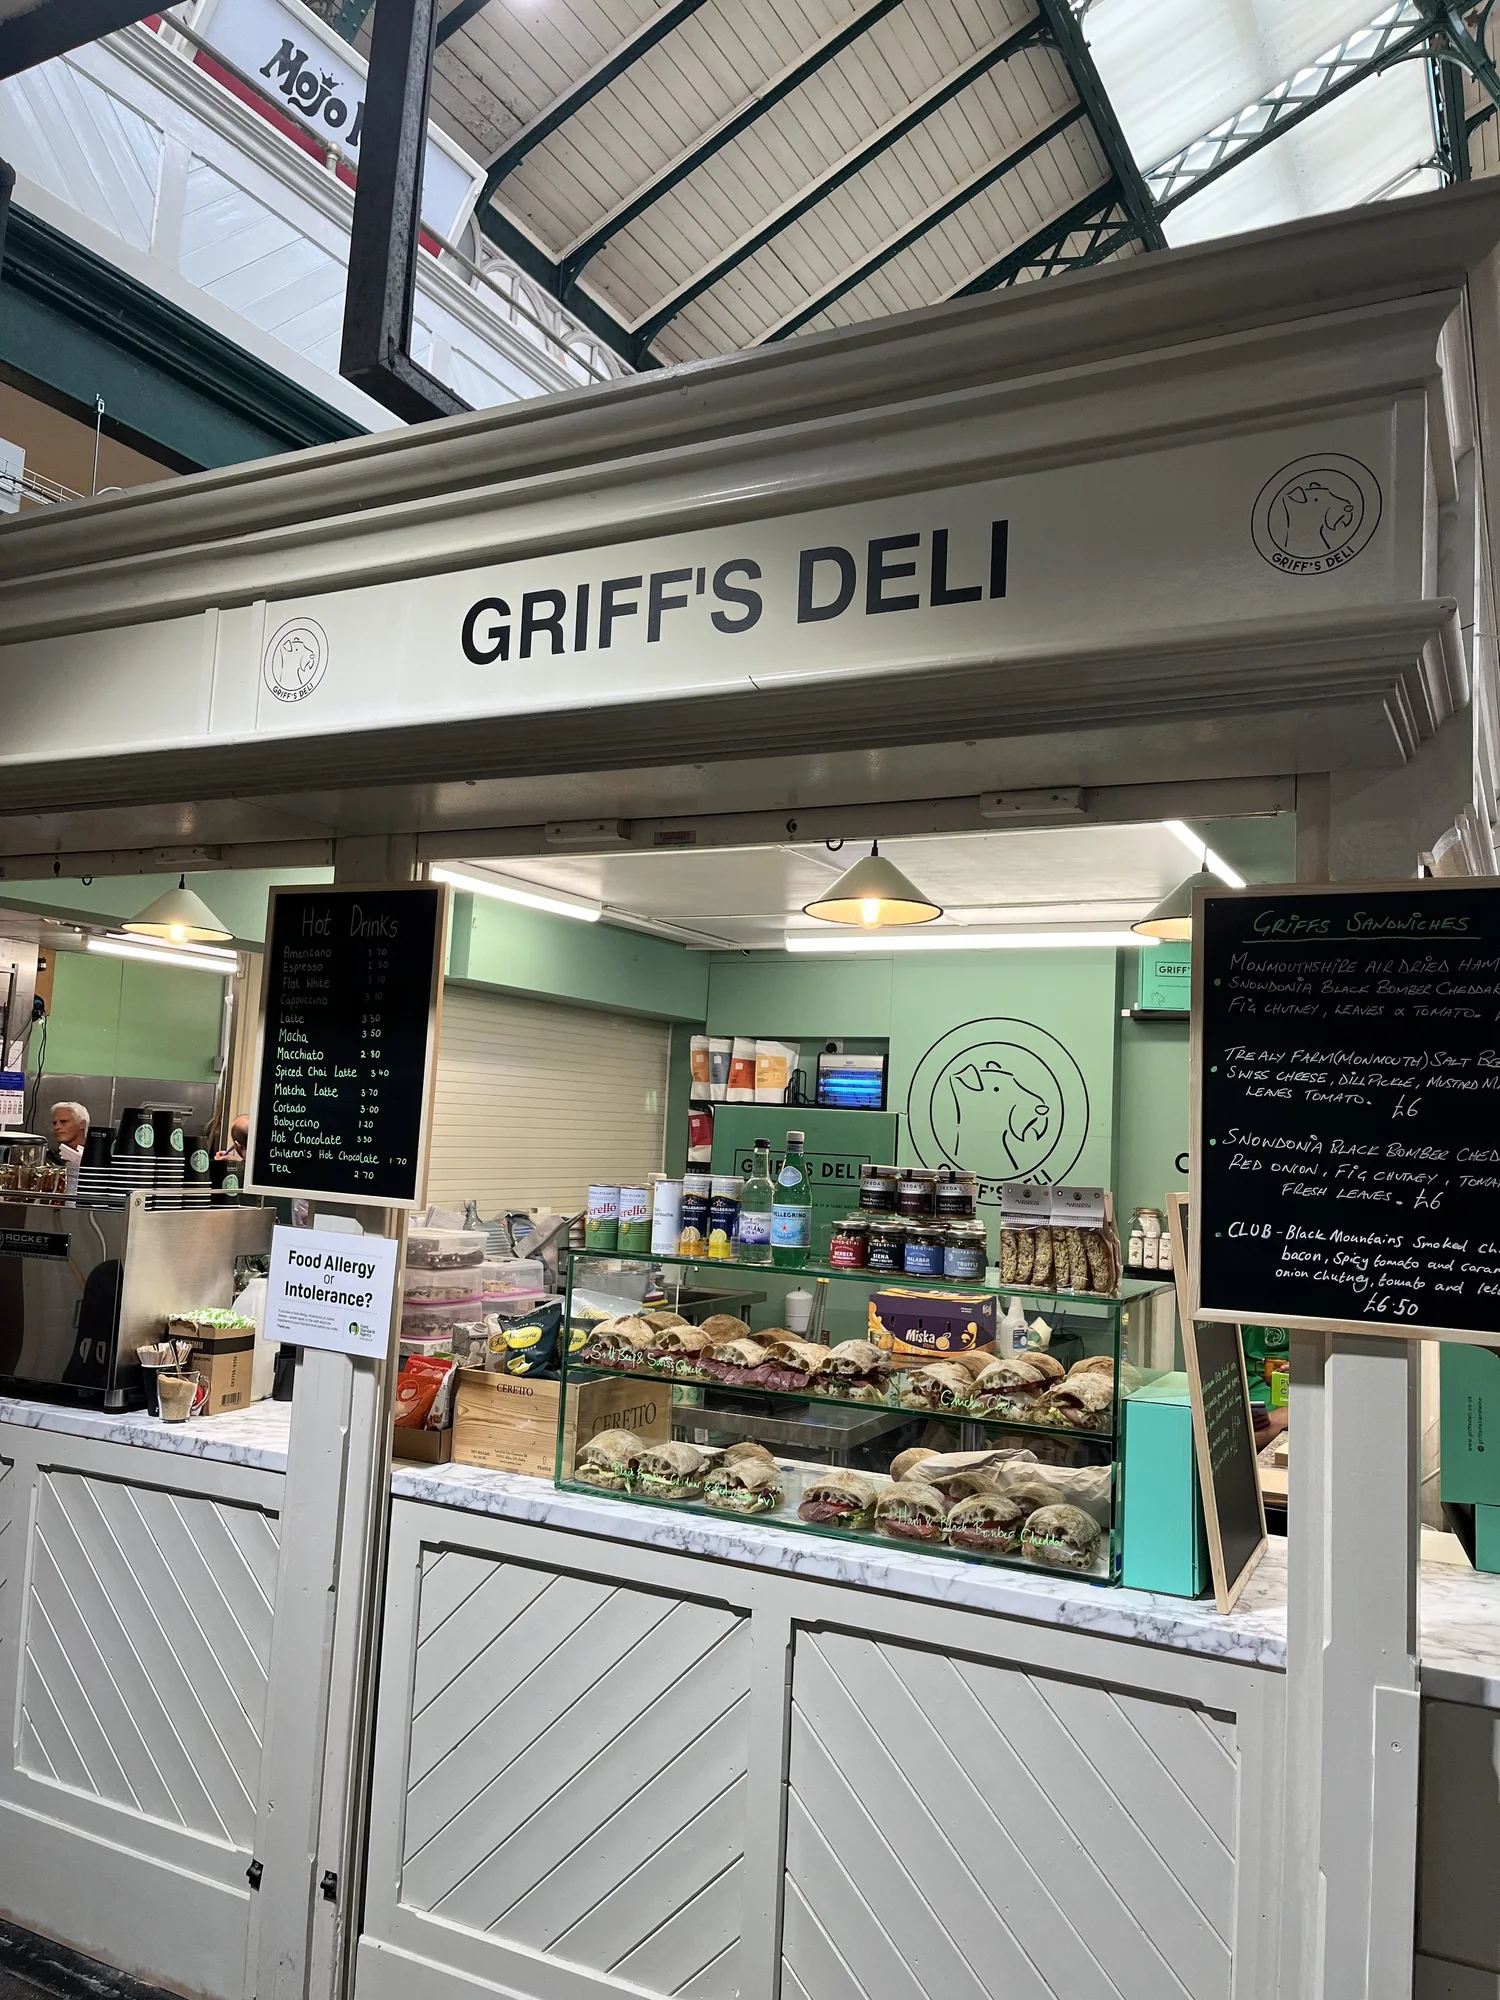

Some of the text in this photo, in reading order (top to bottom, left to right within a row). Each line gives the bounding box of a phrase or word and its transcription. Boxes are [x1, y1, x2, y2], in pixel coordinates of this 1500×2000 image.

[1271, 545, 1355, 572] GRIFF'S DELI
[460, 519, 1009, 666] GRIFF'S DELI
[272, 682, 314, 700] GRIFF'S DELI
[302, 904, 398, 938] Hot Drinks
[283, 945, 332, 958] Americano
[282, 962, 324, 975] Espresso
[1365, 959, 1393, 974] AIR
[1458, 957, 1500, 973] HAM
[282, 977, 301, 989] Flat
[306, 977, 331, 989] White
[1321, 978, 1370, 994] BLACK
[1376, 977, 1432, 995] BOMBER
[280, 993, 329, 1011] Cappuccino
[1334, 1004, 1385, 1016] LEAVES
[279, 1011, 305, 1024] Latte
[278, 1027, 309, 1044] Mocha
[276, 1046, 324, 1060] Macchiato
[1429, 1051, 1472, 1068] SALT
[275, 1064, 303, 1080] Spiced
[308, 1066, 328, 1077] Chai
[334, 1064, 358, 1078] Latte
[1226, 1066, 1270, 1080] SWISS
[1426, 1075, 1479, 1091] MUSTARD
[274, 1082, 307, 1097] Matcha
[313, 1082, 339, 1098] Latte
[1245, 1085, 1292, 1098] LEAVES
[272, 1100, 307, 1113] Cortado
[1391, 1094, 1422, 1119] £6
[273, 1114, 320, 1131] Babyccino
[270, 1130, 287, 1143] Hot
[294, 1131, 342, 1145] Chocolate
[269, 1146, 312, 1159] Children's
[318, 1149, 334, 1160] Hot
[338, 1150, 380, 1164] Chocolate
[1330, 1139, 1380, 1157] BLACK
[1386, 1142, 1450, 1161] BOMBER
[269, 1163, 291, 1174] Tea
[1228, 1153, 1263, 1171] RED
[821, 1162, 862, 1180] DELI
[1281, 1182, 1328, 1198] FRESH
[1413, 1188, 1444, 1211] £6
[5, 1233, 50, 1244] ROCKET
[1228, 1221, 1273, 1239] CLUB
[1285, 1224, 1327, 1241] Black
[1329, 1228, 1404, 1248] Mountains
[1412, 1236, 1468, 1254] Smoked
[288, 1249, 376, 1279] Food Allergy
[1374, 1254, 1420, 1269] tomato
[1427, 1257, 1453, 1271] and
[323, 1274, 335, 1285] or
[1275, 1267, 1309, 1279] onion
[1378, 1274, 1426, 1289] tomato
[1435, 1280, 1463, 1295] and
[284, 1280, 373, 1308] Intolerance?
[905, 1328, 936, 1344] Miska
[496, 1383, 534, 1397] CERETTO
[925, 1516, 933, 1528] &
[1020, 1528, 1065, 1548] Cheddar
